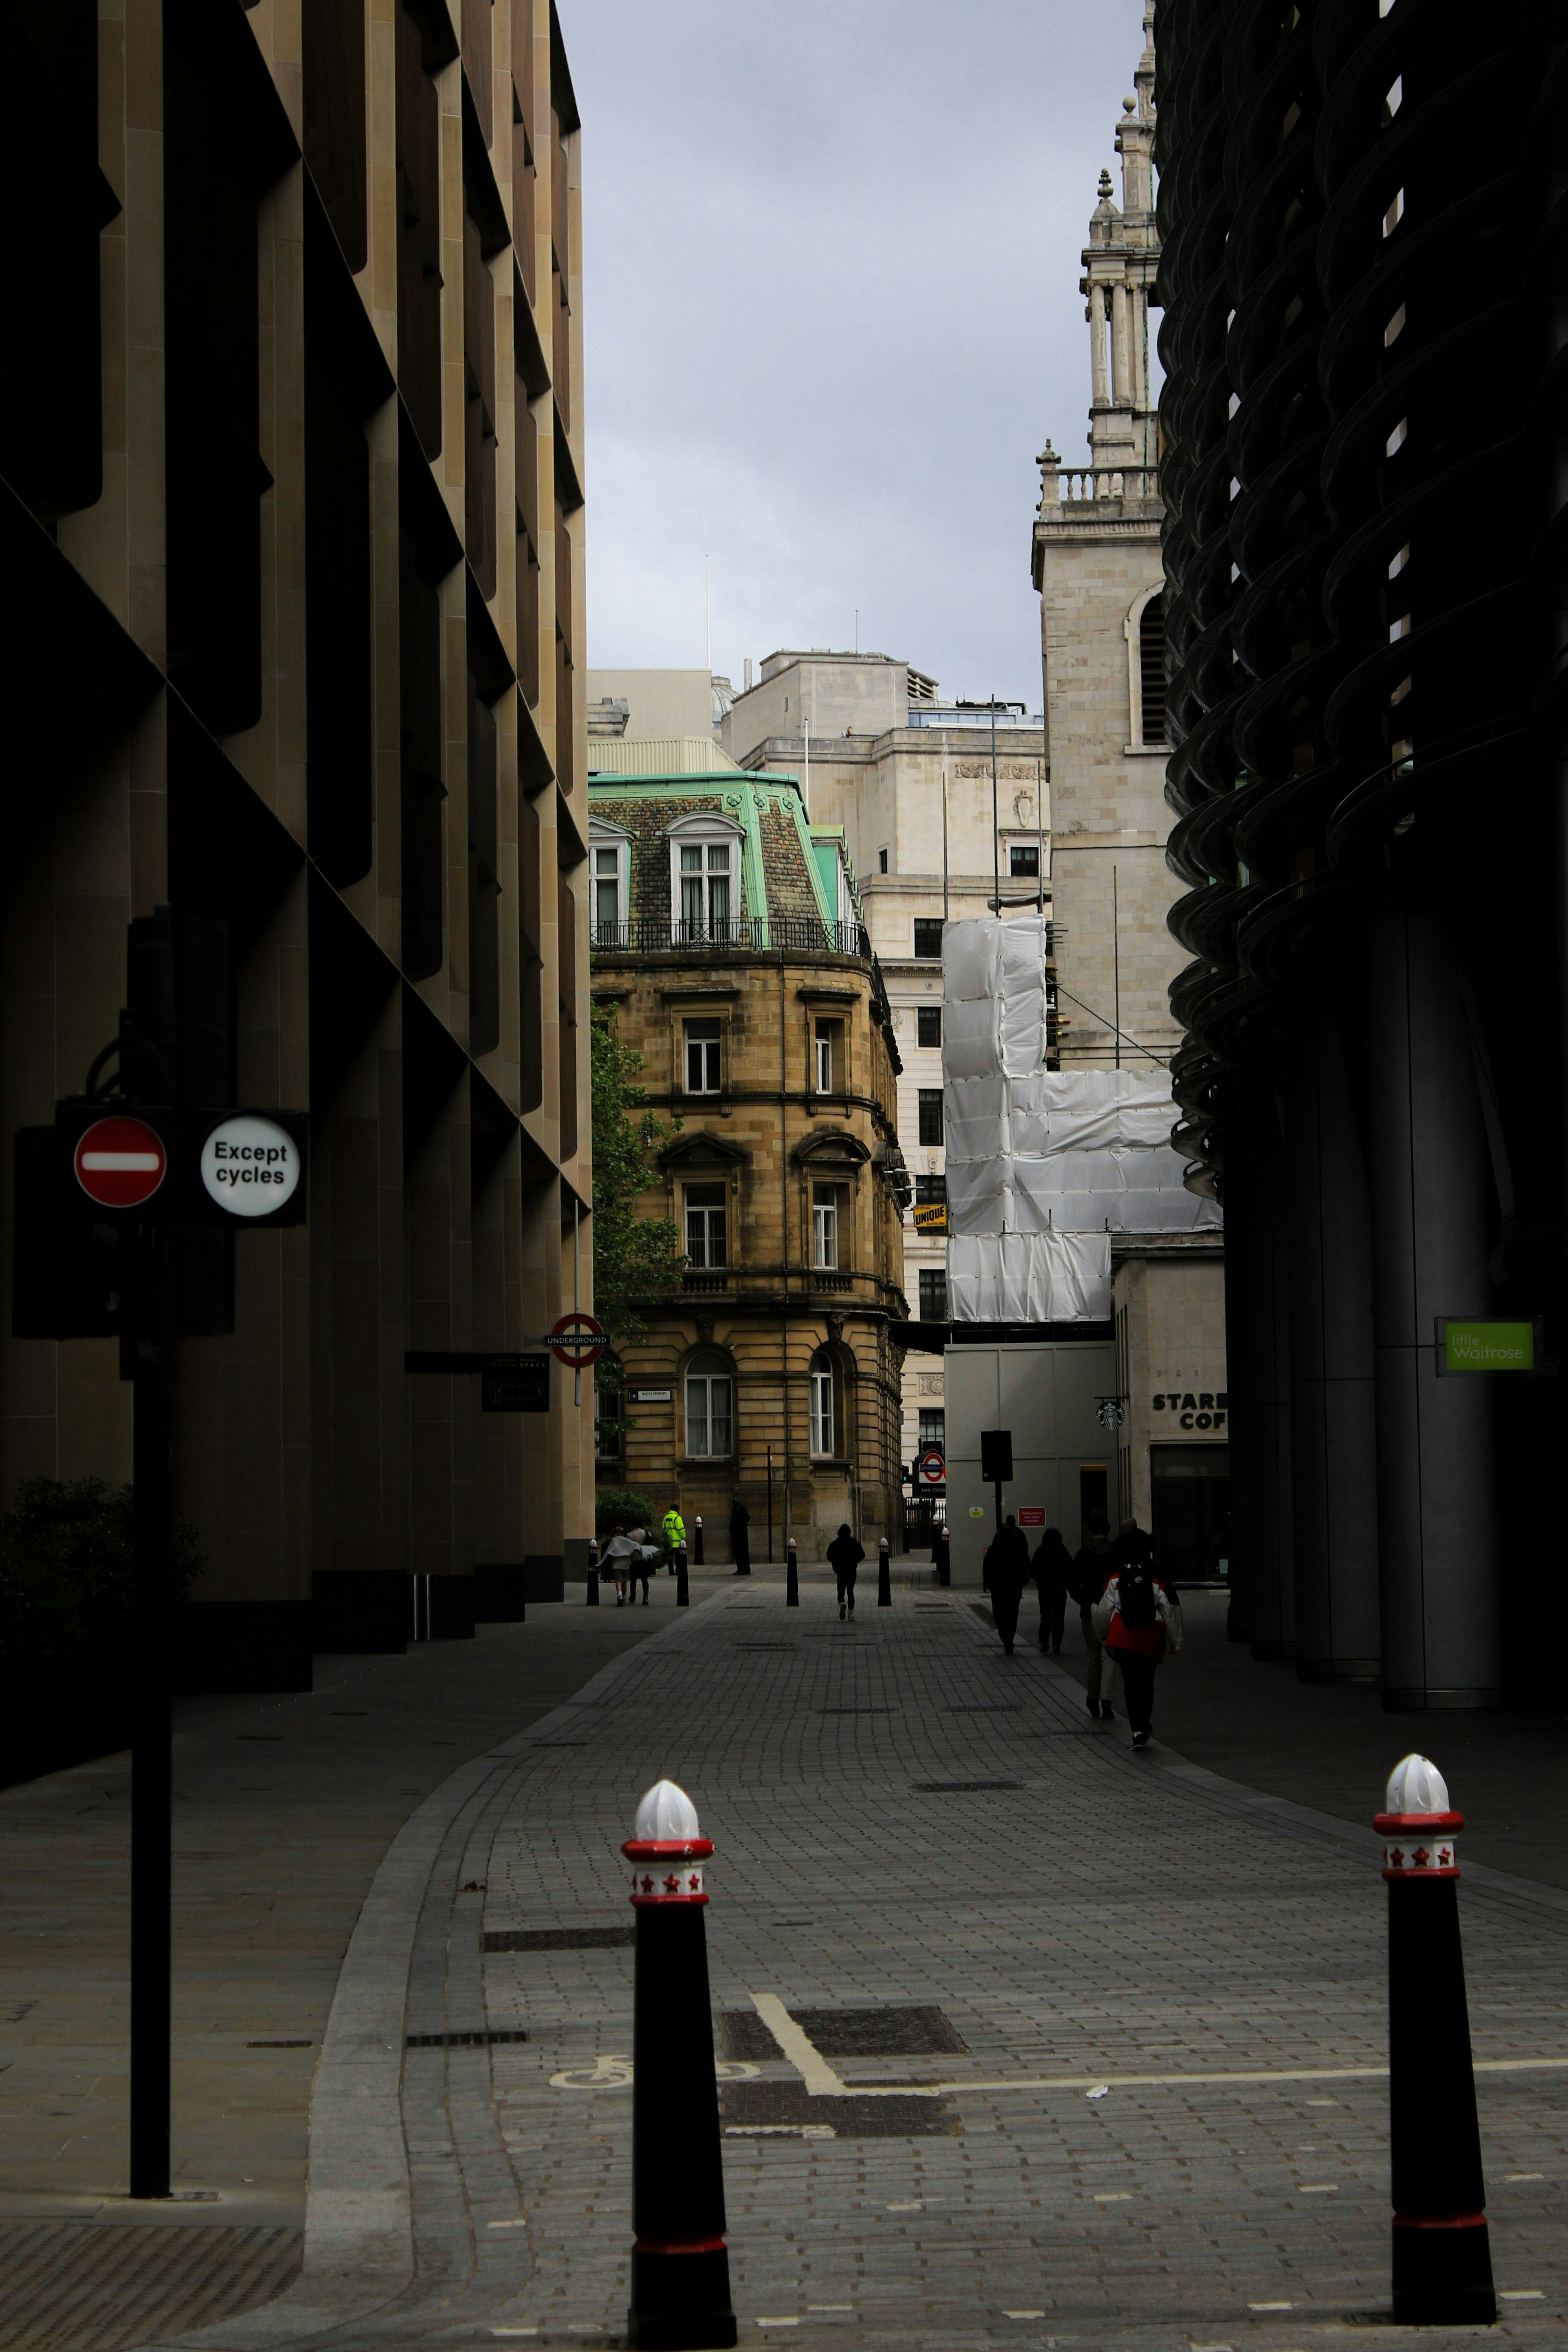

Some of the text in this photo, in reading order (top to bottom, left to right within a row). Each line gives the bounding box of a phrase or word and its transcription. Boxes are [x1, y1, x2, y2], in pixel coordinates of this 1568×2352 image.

[215, 1141, 287, 1165] Except
[216, 1166, 284, 1187] cycles
[916, 1206, 944, 1225] UNIQUE
[1452, 1334, 1479, 1346] little
[1453, 1346, 1523, 1360] Waitrose
[1179, 1412, 1226, 1430] COF
